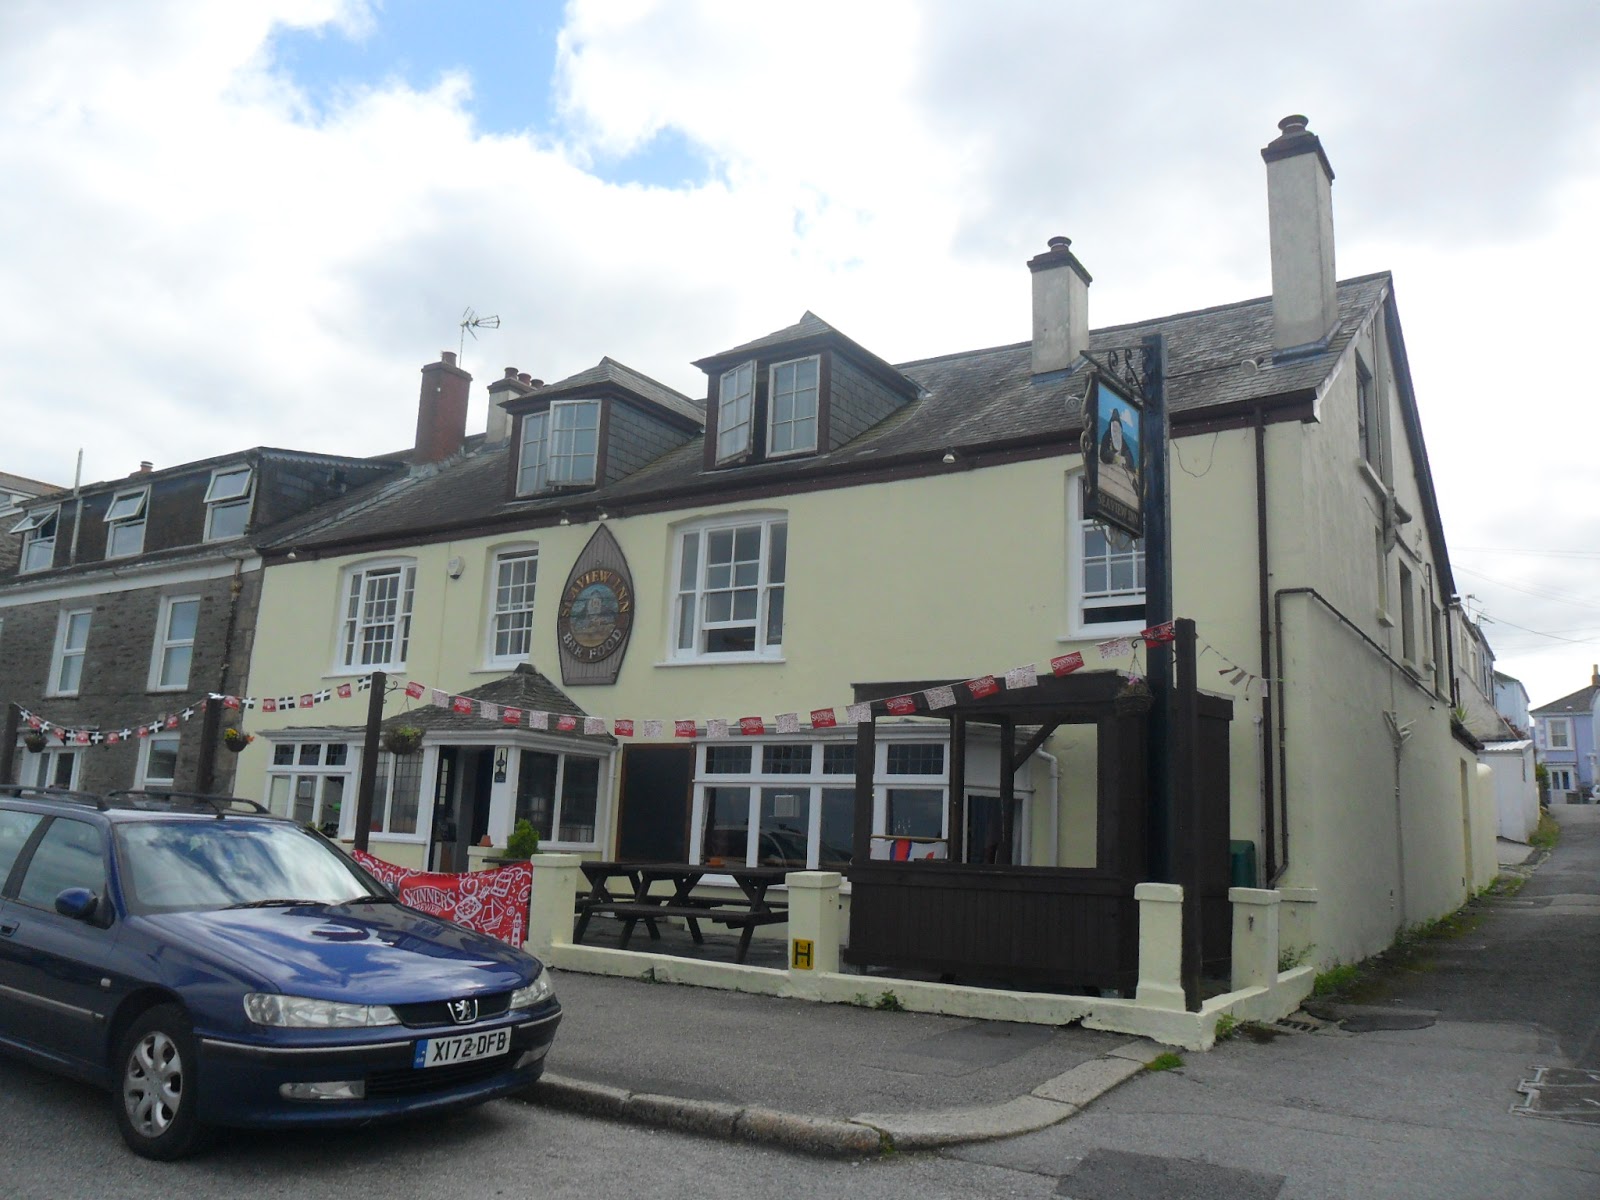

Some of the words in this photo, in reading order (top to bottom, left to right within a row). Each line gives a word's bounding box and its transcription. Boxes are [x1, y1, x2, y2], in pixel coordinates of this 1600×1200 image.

[562, 570, 612, 617] SEAVIEW
[613, 579, 630, 613] INN
[563, 631, 584, 657] BAR
[589, 629, 622, 659] FOOD
[403, 886, 456, 911] SKINNER'S
[795, 941, 811, 967] H
[433, 1037, 473, 1062] X172
[476, 1031, 507, 1056] DFB
